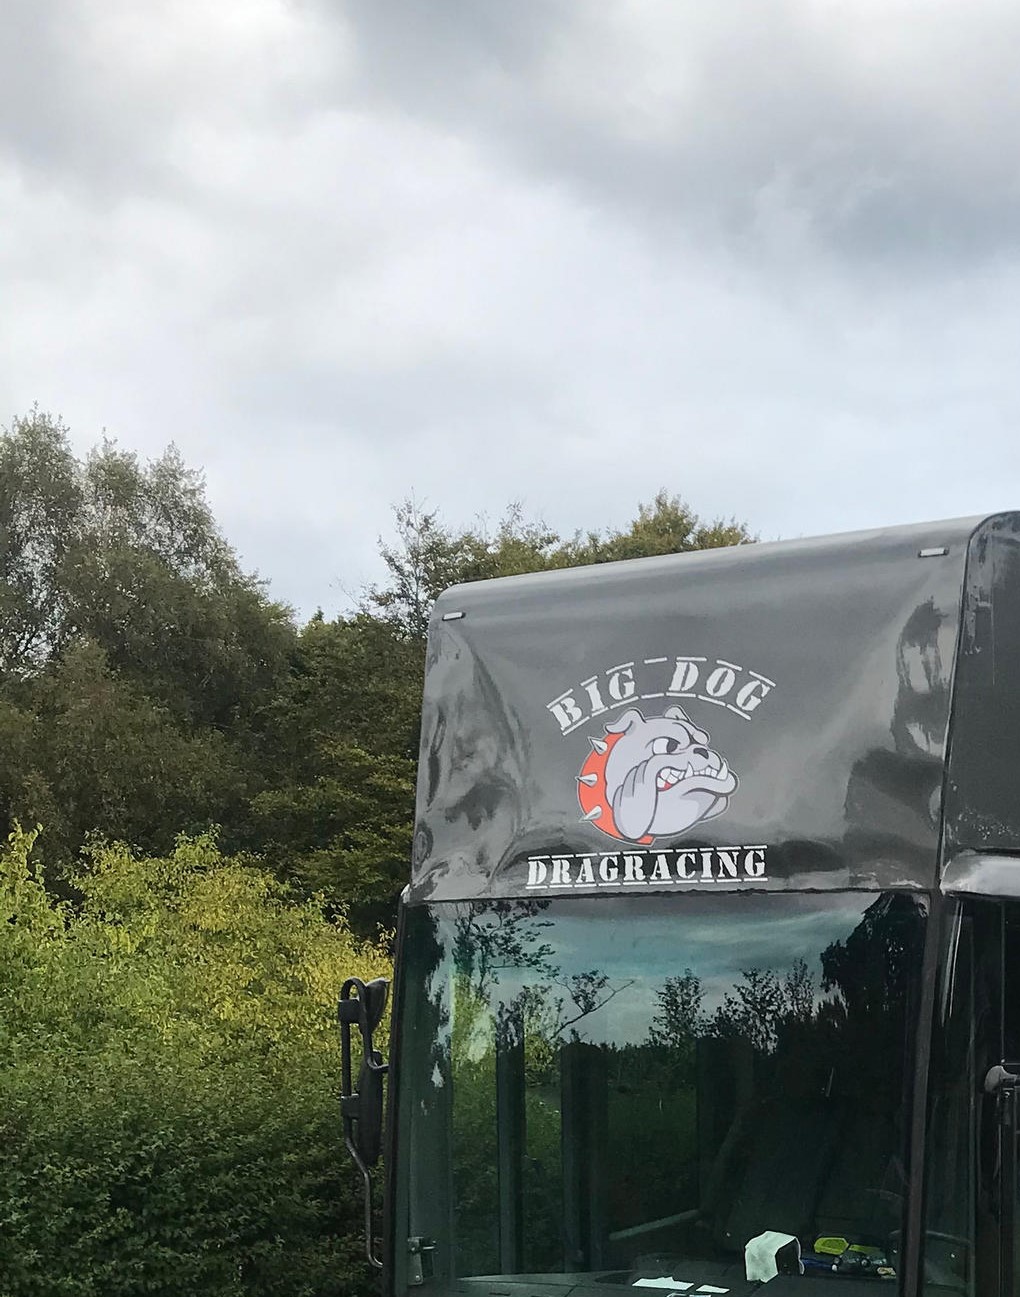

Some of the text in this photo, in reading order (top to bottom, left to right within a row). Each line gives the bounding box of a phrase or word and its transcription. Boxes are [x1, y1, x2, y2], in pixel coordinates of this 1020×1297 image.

[547, 657, 775, 734] BIG DOG
[526, 847, 768, 888] DRAGRACING
